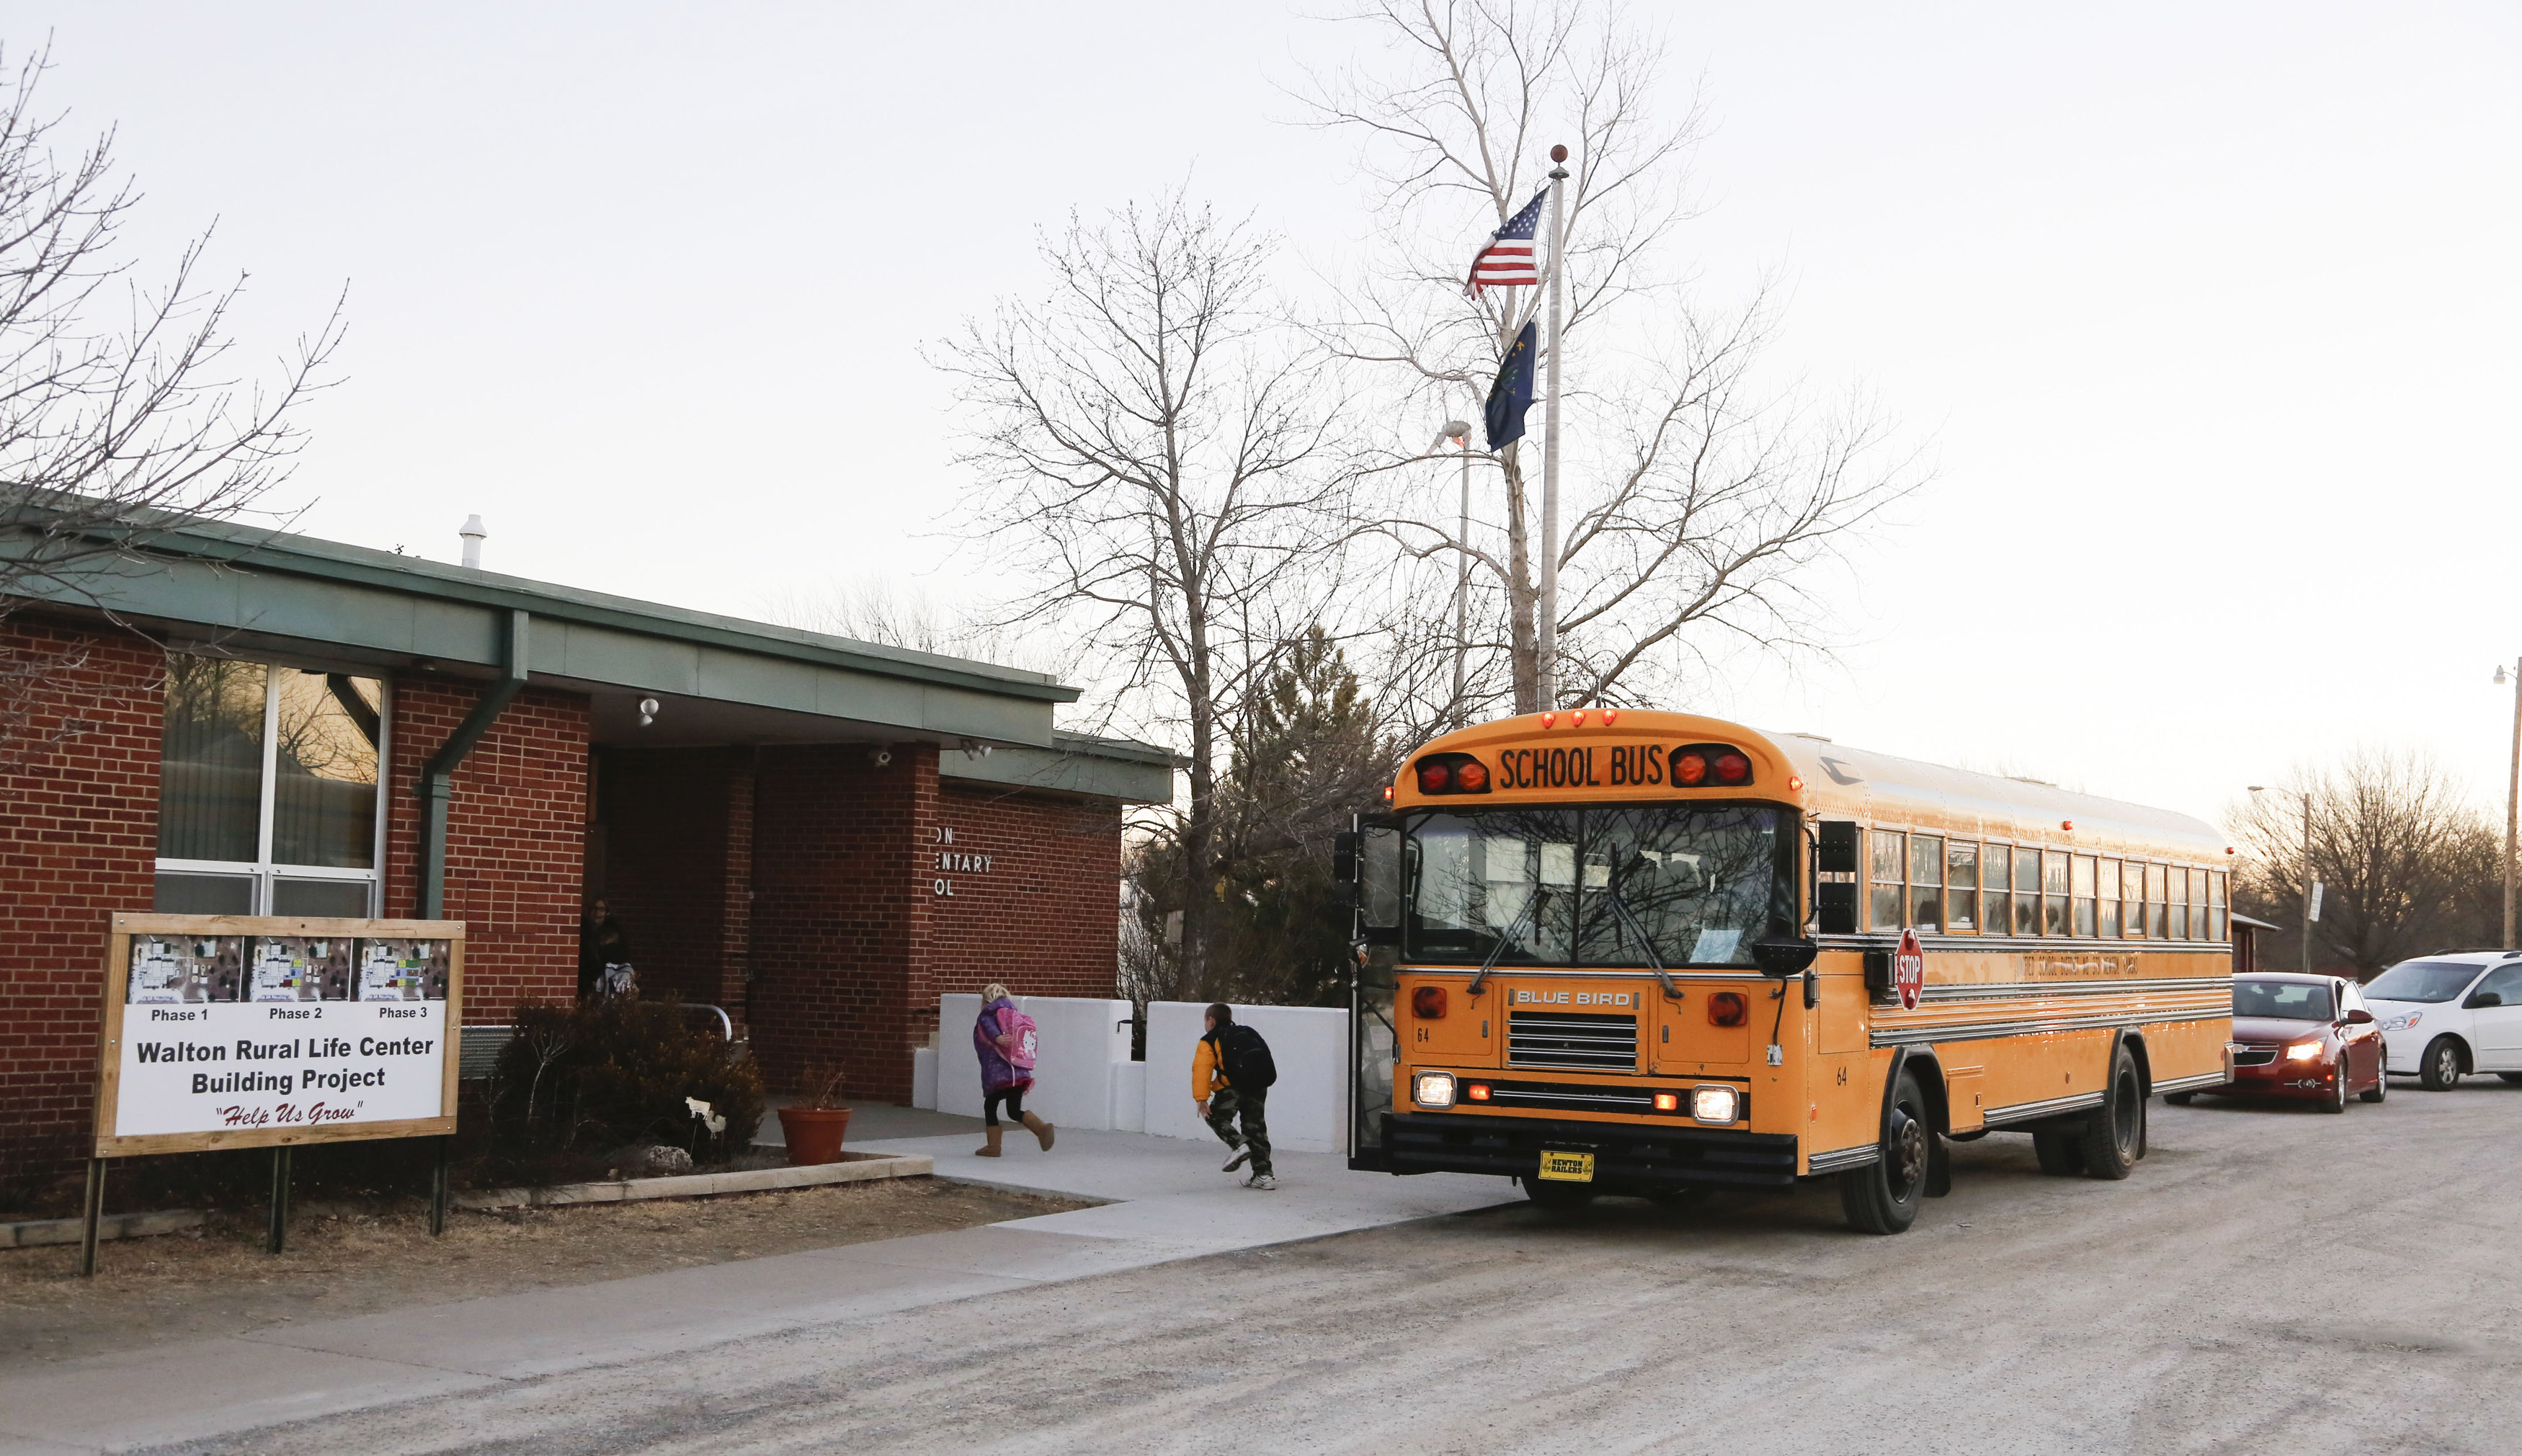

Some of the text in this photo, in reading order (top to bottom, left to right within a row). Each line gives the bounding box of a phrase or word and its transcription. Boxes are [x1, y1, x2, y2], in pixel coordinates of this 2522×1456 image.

[1500, 743, 1664, 789] SCHOOL BUS
[935, 878, 954, 896] OL
[1899, 955, 1920, 983] STOP
[1517, 991, 1630, 1006] BLUE BIRD
[151, 1009, 208, 1021] Phase 1
[269, 1008, 322, 1019] Phase 2
[379, 1006, 427, 1018] Phase 3
[1417, 1027, 1429, 1042] 64
[137, 1036, 435, 1063] Walton Rural Life Center
[192, 1067, 386, 1095] Building Project
[1837, 1066, 1847, 1086] 64
[216, 1100, 364, 1128] "Help Us Grow"
[1552, 1158, 1583, 1167] NEWTON
